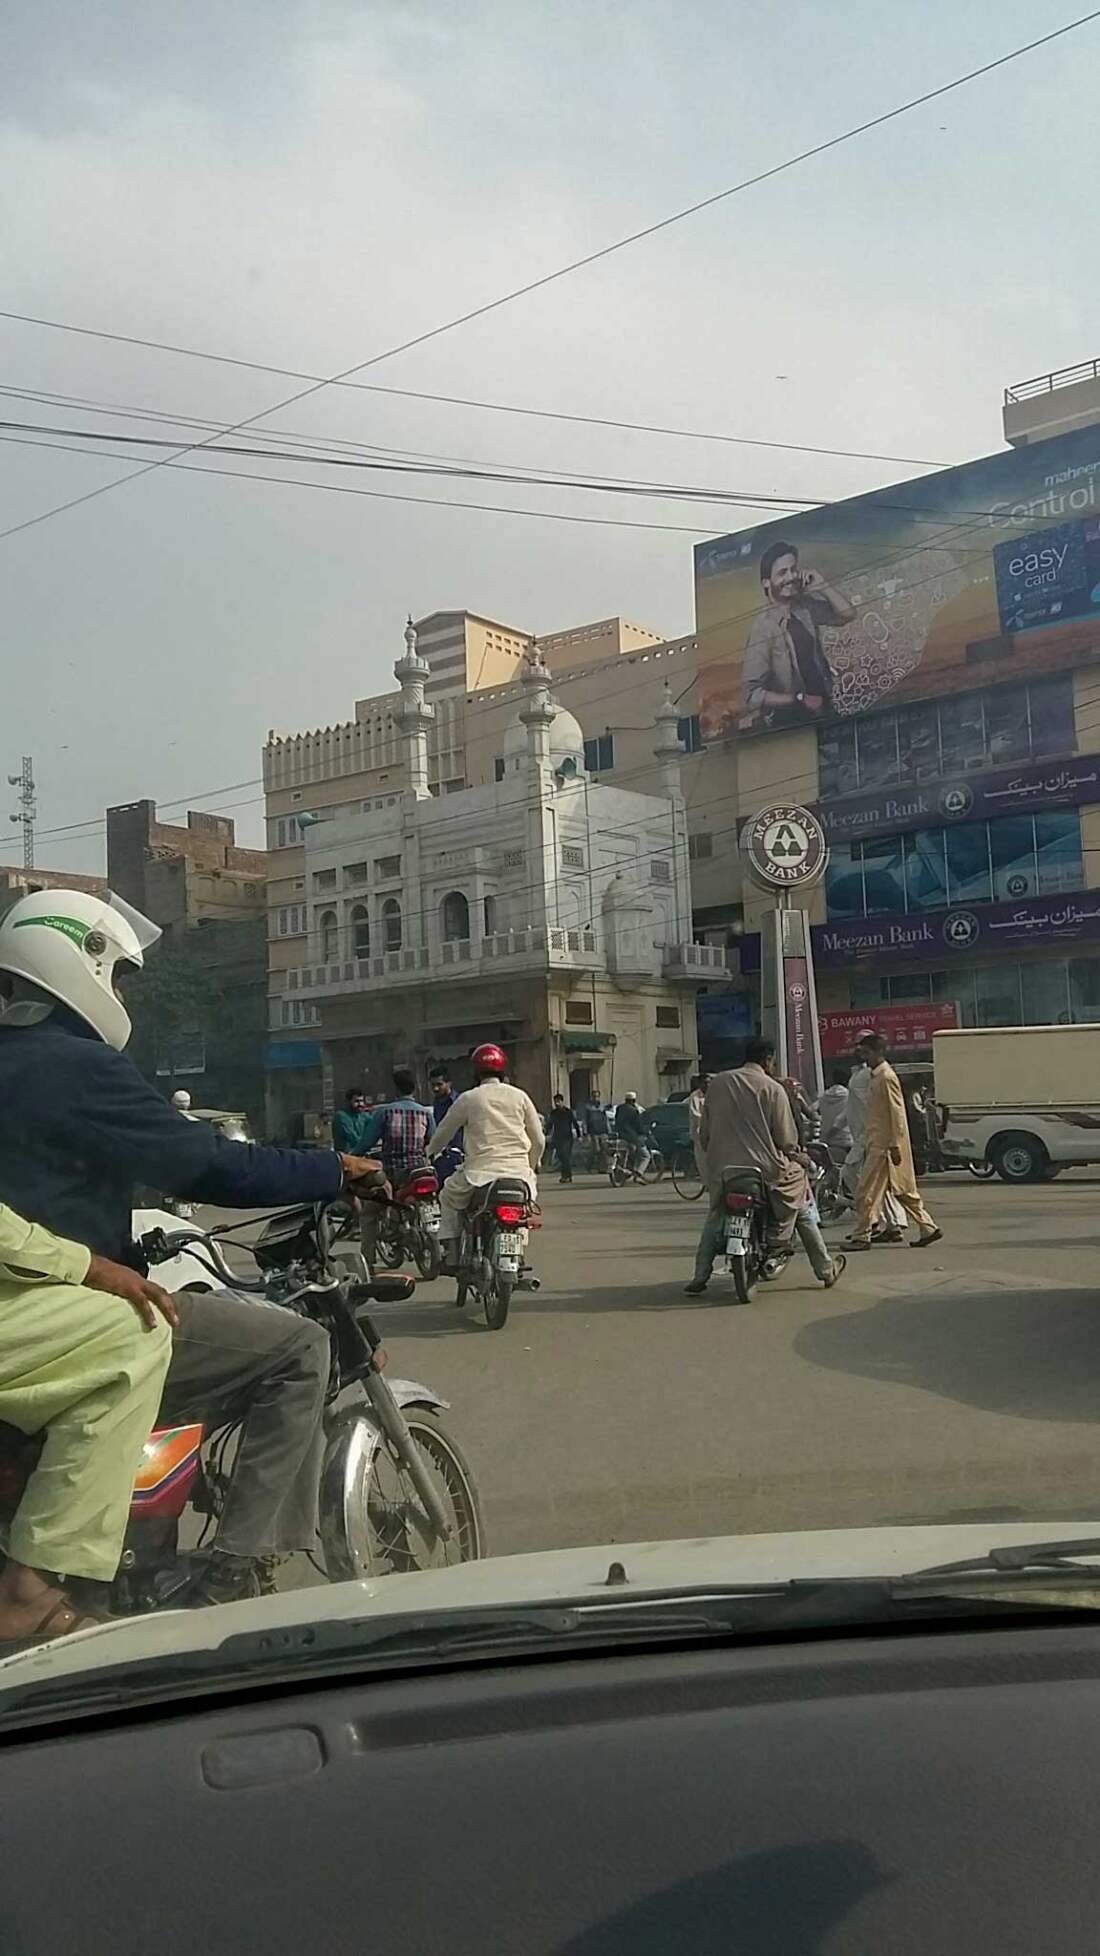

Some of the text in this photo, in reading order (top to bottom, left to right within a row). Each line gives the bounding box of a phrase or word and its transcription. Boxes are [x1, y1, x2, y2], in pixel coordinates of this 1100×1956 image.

[1008, 543, 1069, 576] easy
[1024, 567, 1057, 588] card
[753, 808, 818, 841] MEEZAN
[820, 809, 880, 829] Meezan
[885, 795, 930, 819] Bank
[764, 860, 812, 879] BANK
[44, 916, 84, 938] Careem
[822, 932, 884, 951] Meezan
[889, 921, 935, 944] Bank
[831, 1015, 877, 1029] BAWANY
